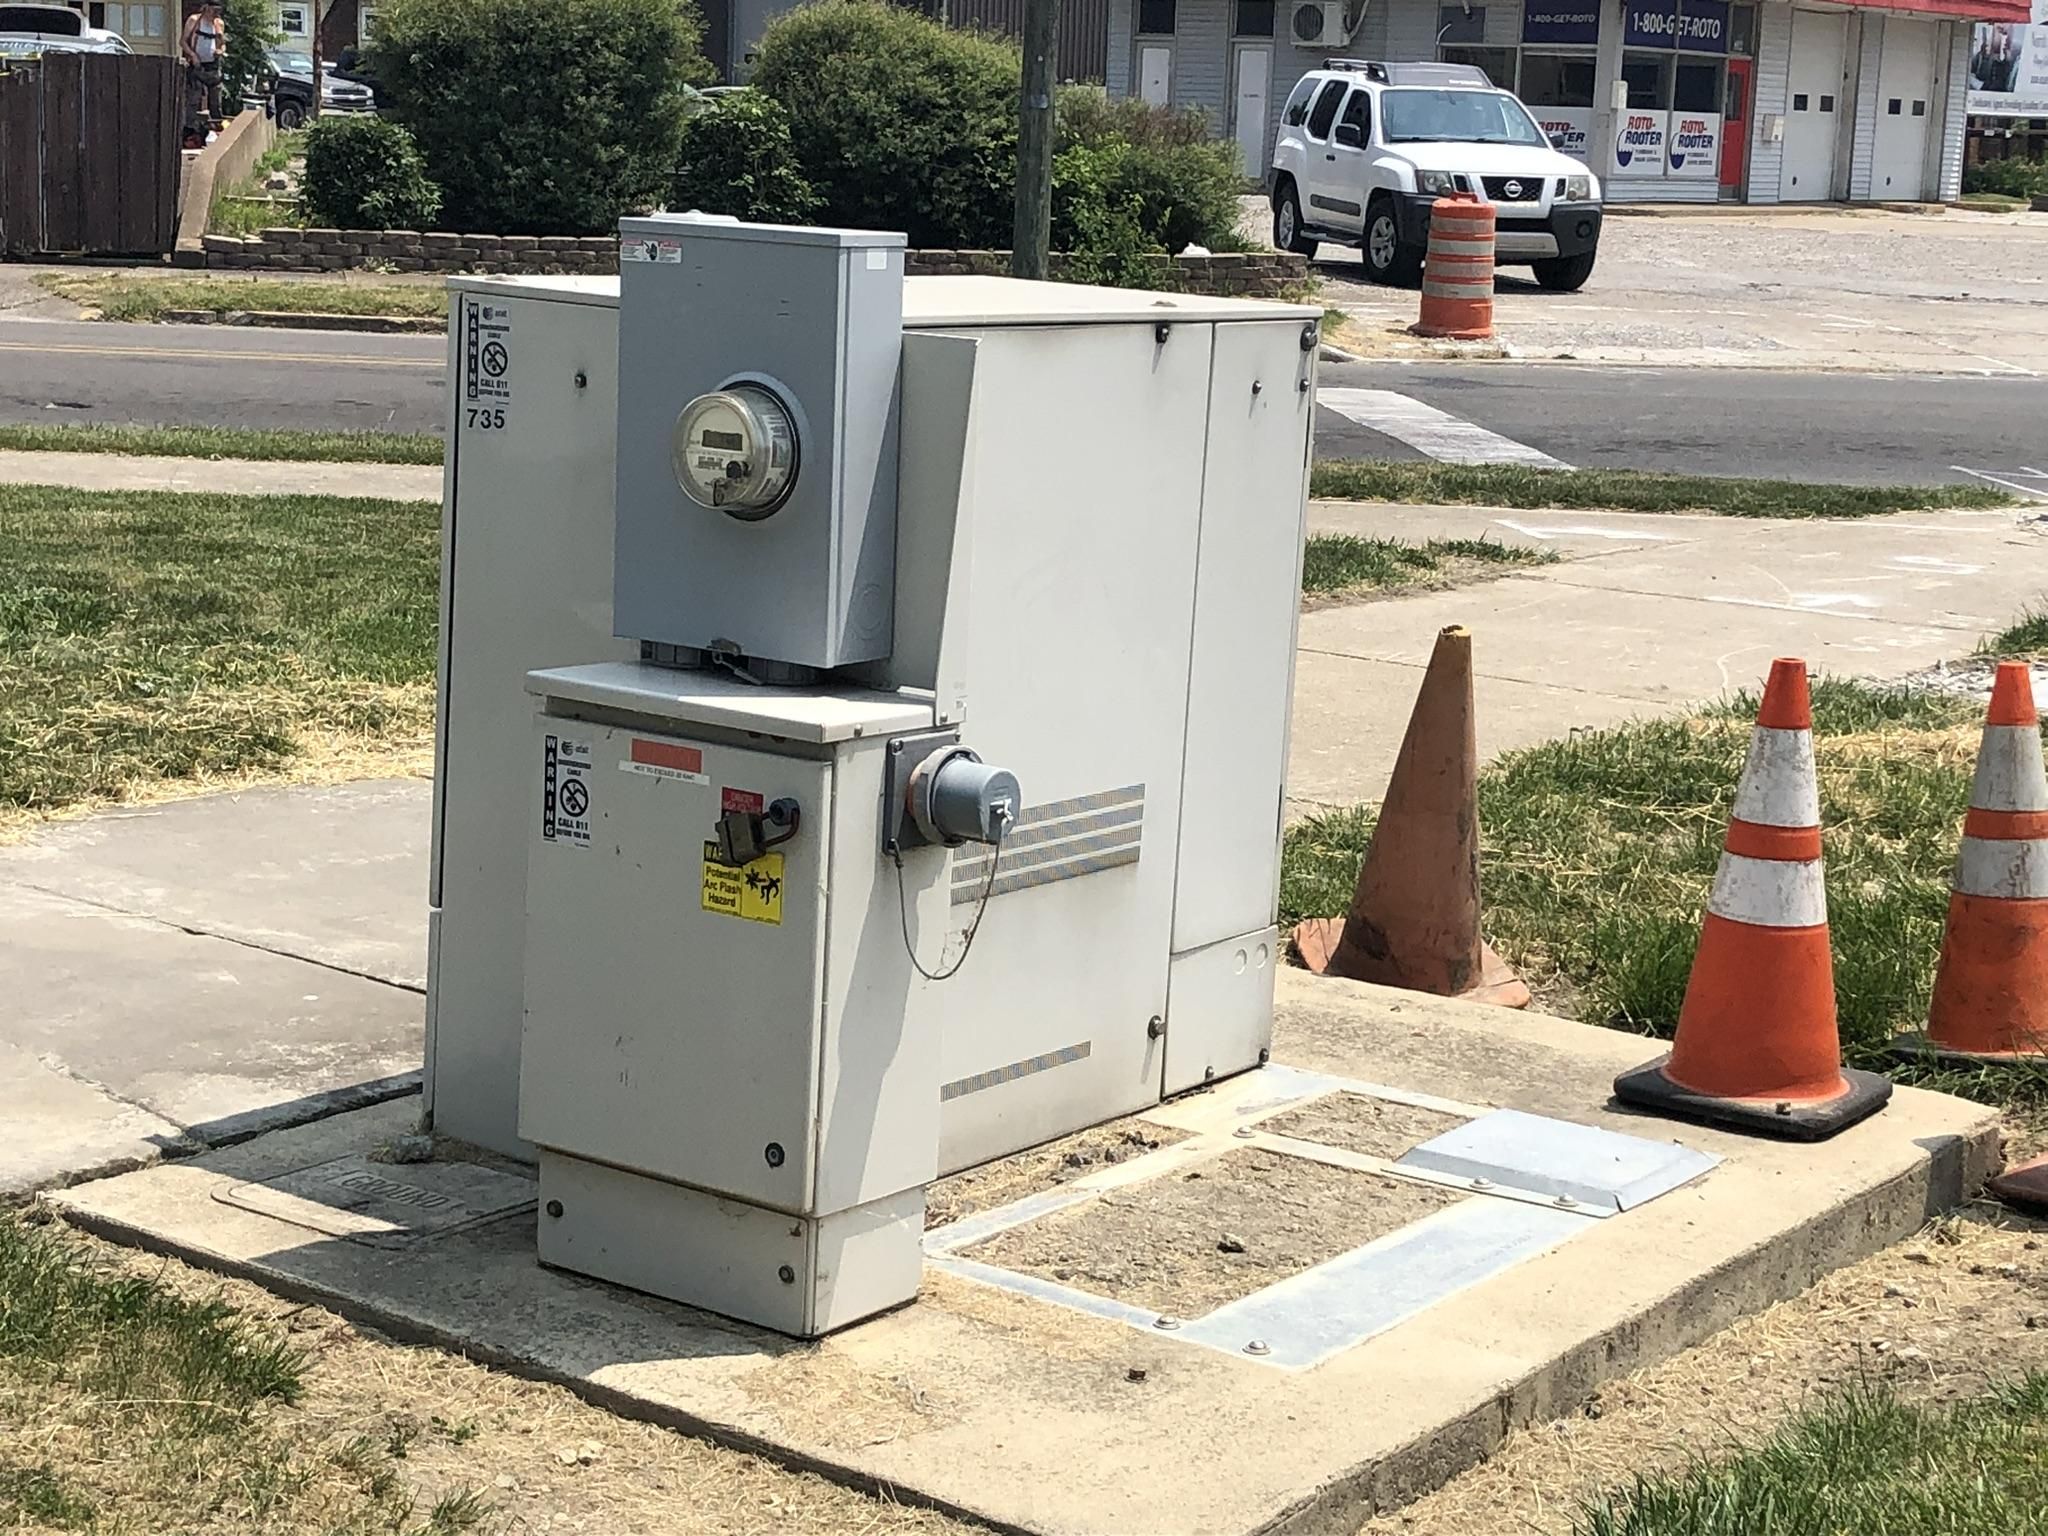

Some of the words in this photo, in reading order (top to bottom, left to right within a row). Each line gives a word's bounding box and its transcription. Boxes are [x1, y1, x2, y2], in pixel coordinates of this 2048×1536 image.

[1527, 14, 1595, 24] 1-800-GET-ROTO
[1632, 12, 1721, 39] 1-800-GET-ROTO
[1628, 115, 1656, 130] ROTO-
[1680, 119, 1708, 134] ROTO-
[1625, 130, 1662, 146] ROOTER
[1678, 133, 1714, 149] ROOTER
[469, 305, 478, 396] WARNING
[467, 408, 505, 428] 735
[545, 737, 556, 836] WARNING
[558, 817, 574, 829] CALL
[706, 865, 740, 882] Potential
[704, 878, 718, 891] Arc
[720, 881, 741, 895] Flash
[708, 892, 736, 908] Hazard
[342, 1175, 450, 1209] GROUND
